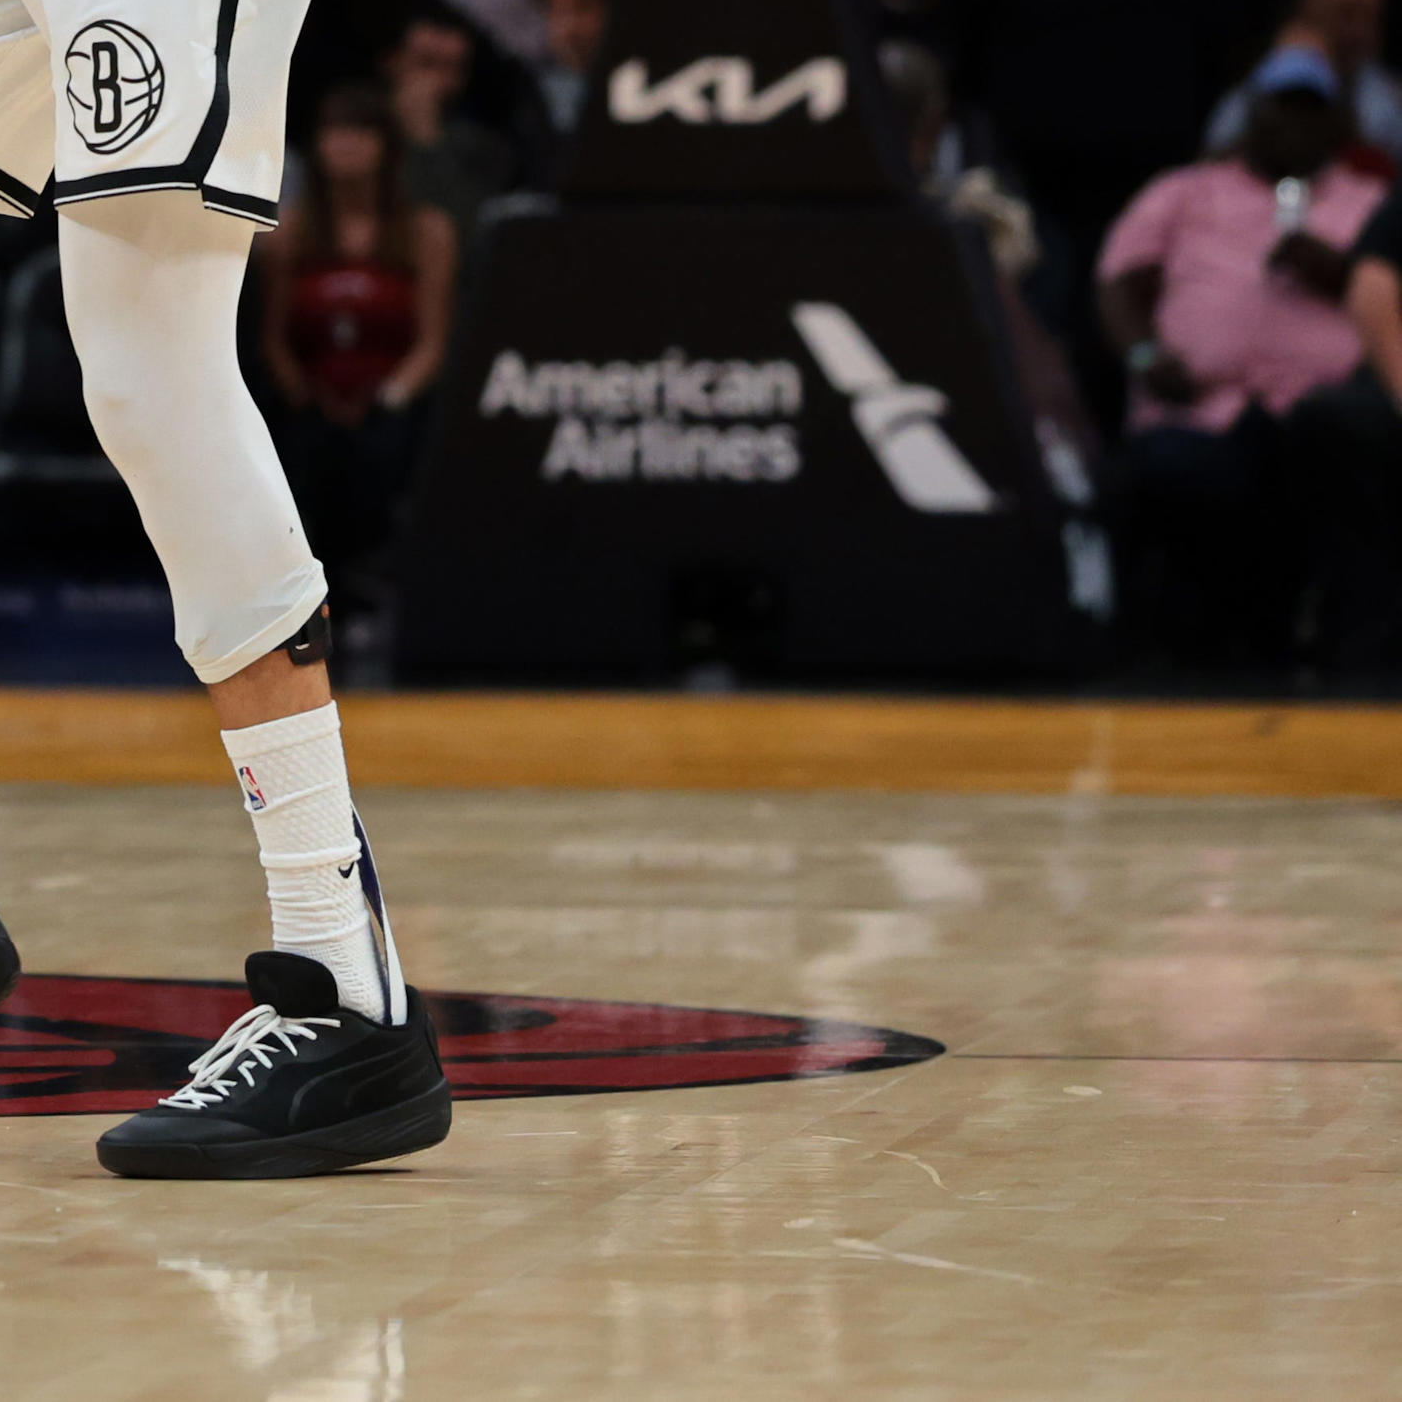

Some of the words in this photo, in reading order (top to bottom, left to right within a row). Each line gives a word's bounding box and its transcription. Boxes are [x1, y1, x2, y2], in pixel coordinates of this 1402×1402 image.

[91, 41, 122, 133] B
[606, 55, 848, 126] KIA
[478, 347, 802, 419] American
[539, 416, 802, 481] Airlines
